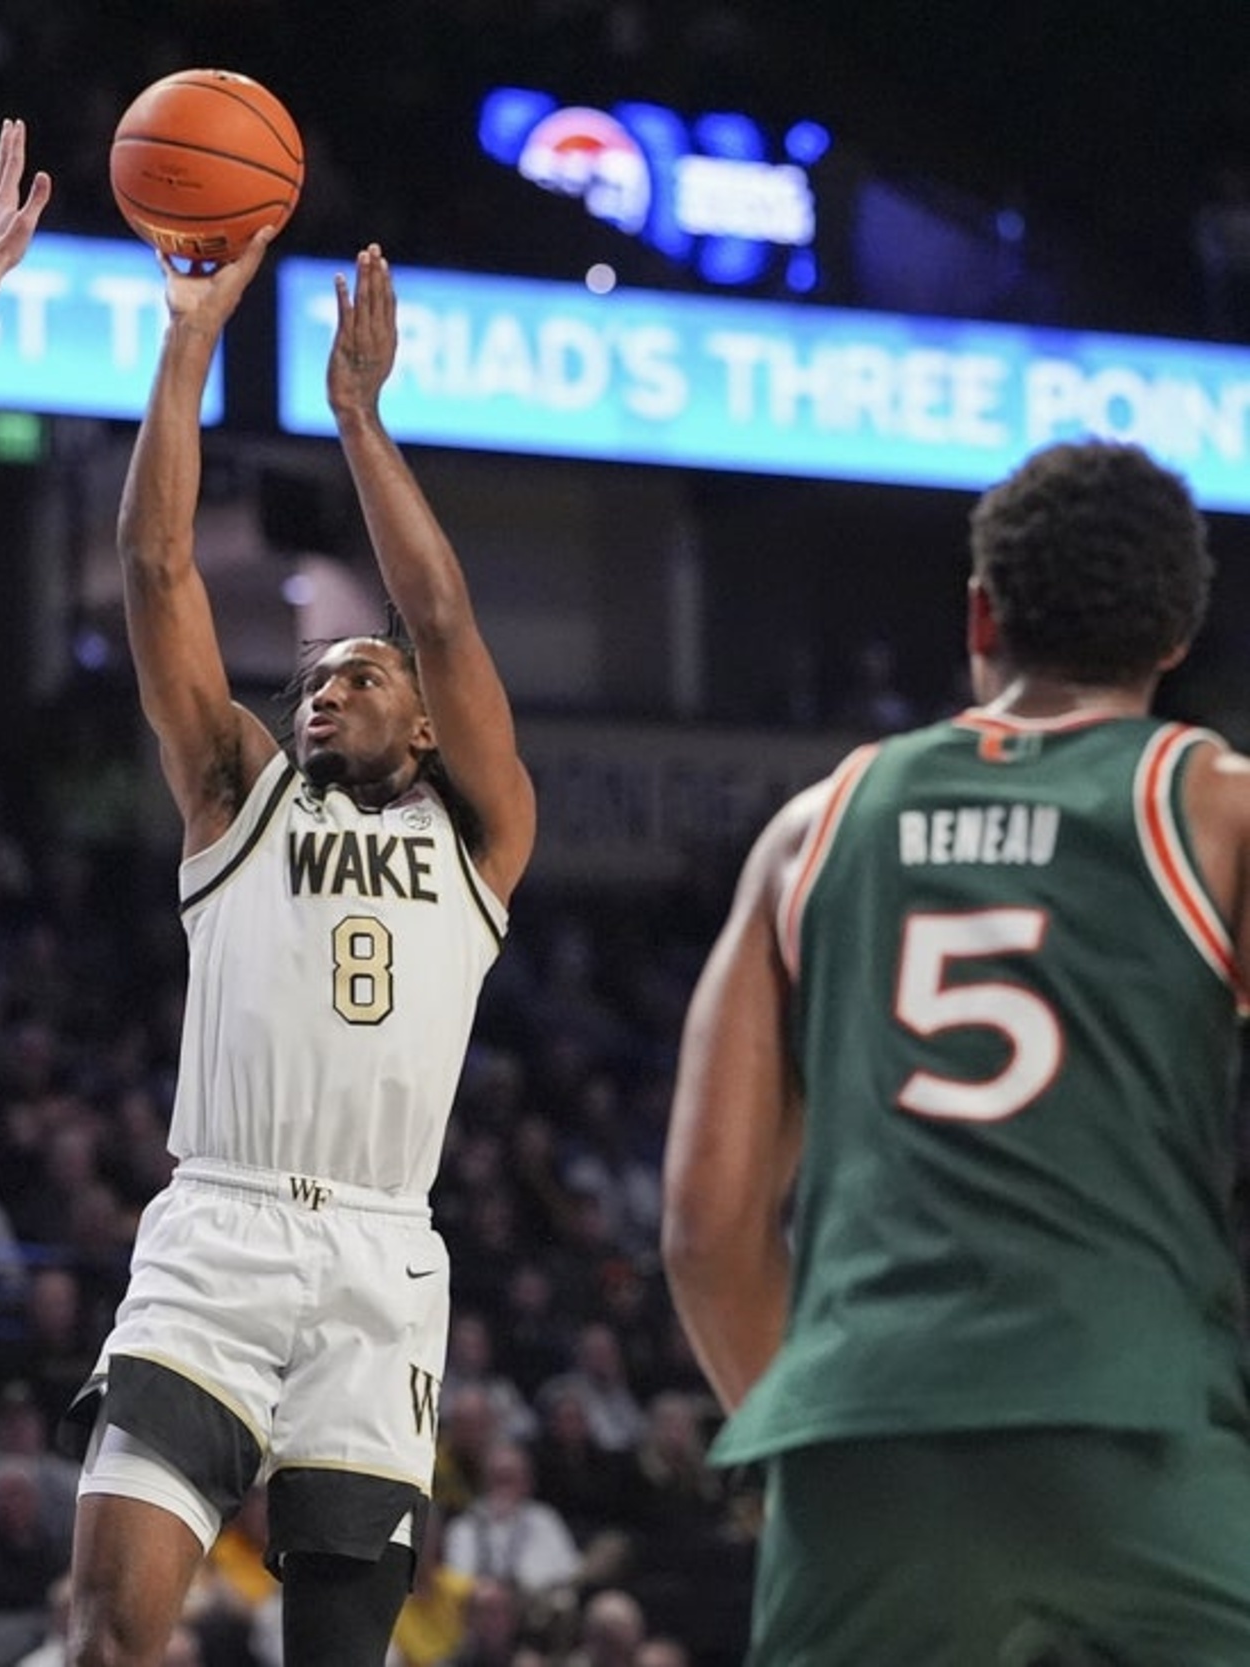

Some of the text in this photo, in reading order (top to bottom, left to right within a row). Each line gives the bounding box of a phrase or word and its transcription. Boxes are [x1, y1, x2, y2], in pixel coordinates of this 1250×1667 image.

[308, 295, 691, 422] RIAD'S
[707, 330, 1008, 448] THREE
[287, 829, 440, 905] WAKE
[898, 805, 1061, 867] RENEAU
[331, 915, 394, 1027] 8
[893, 905, 1067, 1122] 5
[289, 1176, 333, 1212] WF
